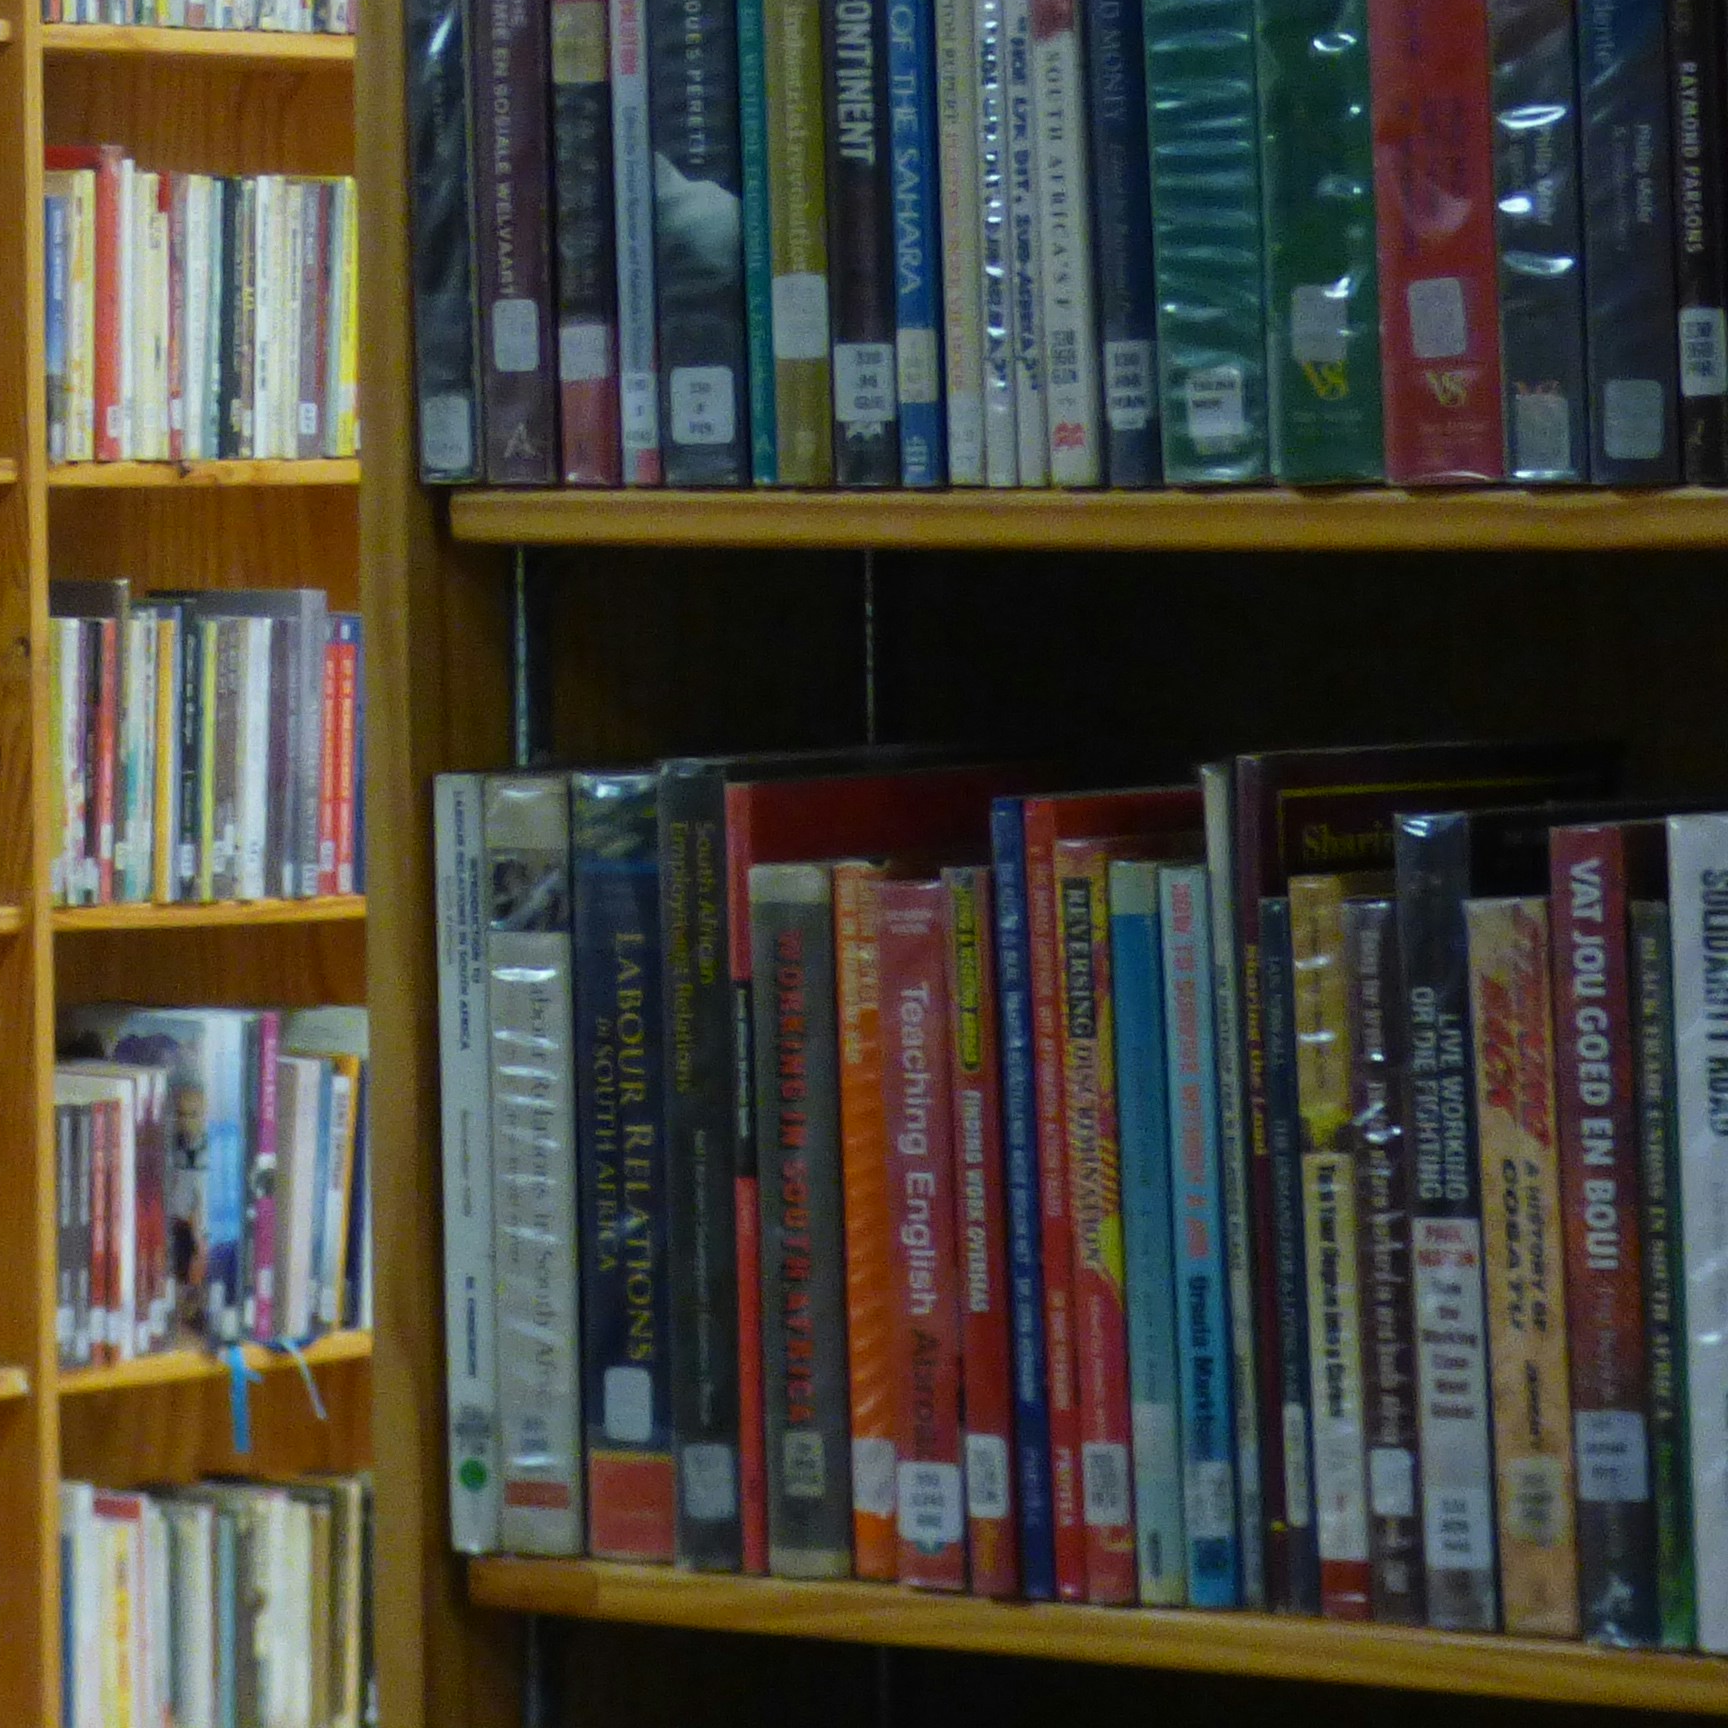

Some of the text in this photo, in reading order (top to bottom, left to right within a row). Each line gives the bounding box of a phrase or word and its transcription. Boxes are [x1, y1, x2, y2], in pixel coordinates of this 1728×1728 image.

[888, 3, 915, 55] OF
[686, 68, 707, 165] PERETTI
[890, 72, 920, 133] THE
[1680, 61, 1704, 254] RAYMOND PARSONS
[897, 147, 923, 295] SAHARA
[1570, 855, 1604, 922] VAT
[1065, 888, 1093, 1037] REVERSING
[1571, 928, 1608, 999] JOU
[1410, 985, 1444, 1201] OR DIE FIGHTING
[1437, 1012, 1464, 1069] LIVE
[1575, 1006, 1614, 1108] GOED
[593, 1044, 619, 1153] SOUTH
[615, 931, 658, 1362] LABOUR RELATIONS
[896, 982, 938, 1316] Teaching English
[1439, 1074, 1470, 1201] WORKING
[1579, 1115, 1616, 1167] EN
[596, 1164, 620, 1272] AFRICA
[778, 929, 815, 1425] WORKING IN SOUTH AFRICA
